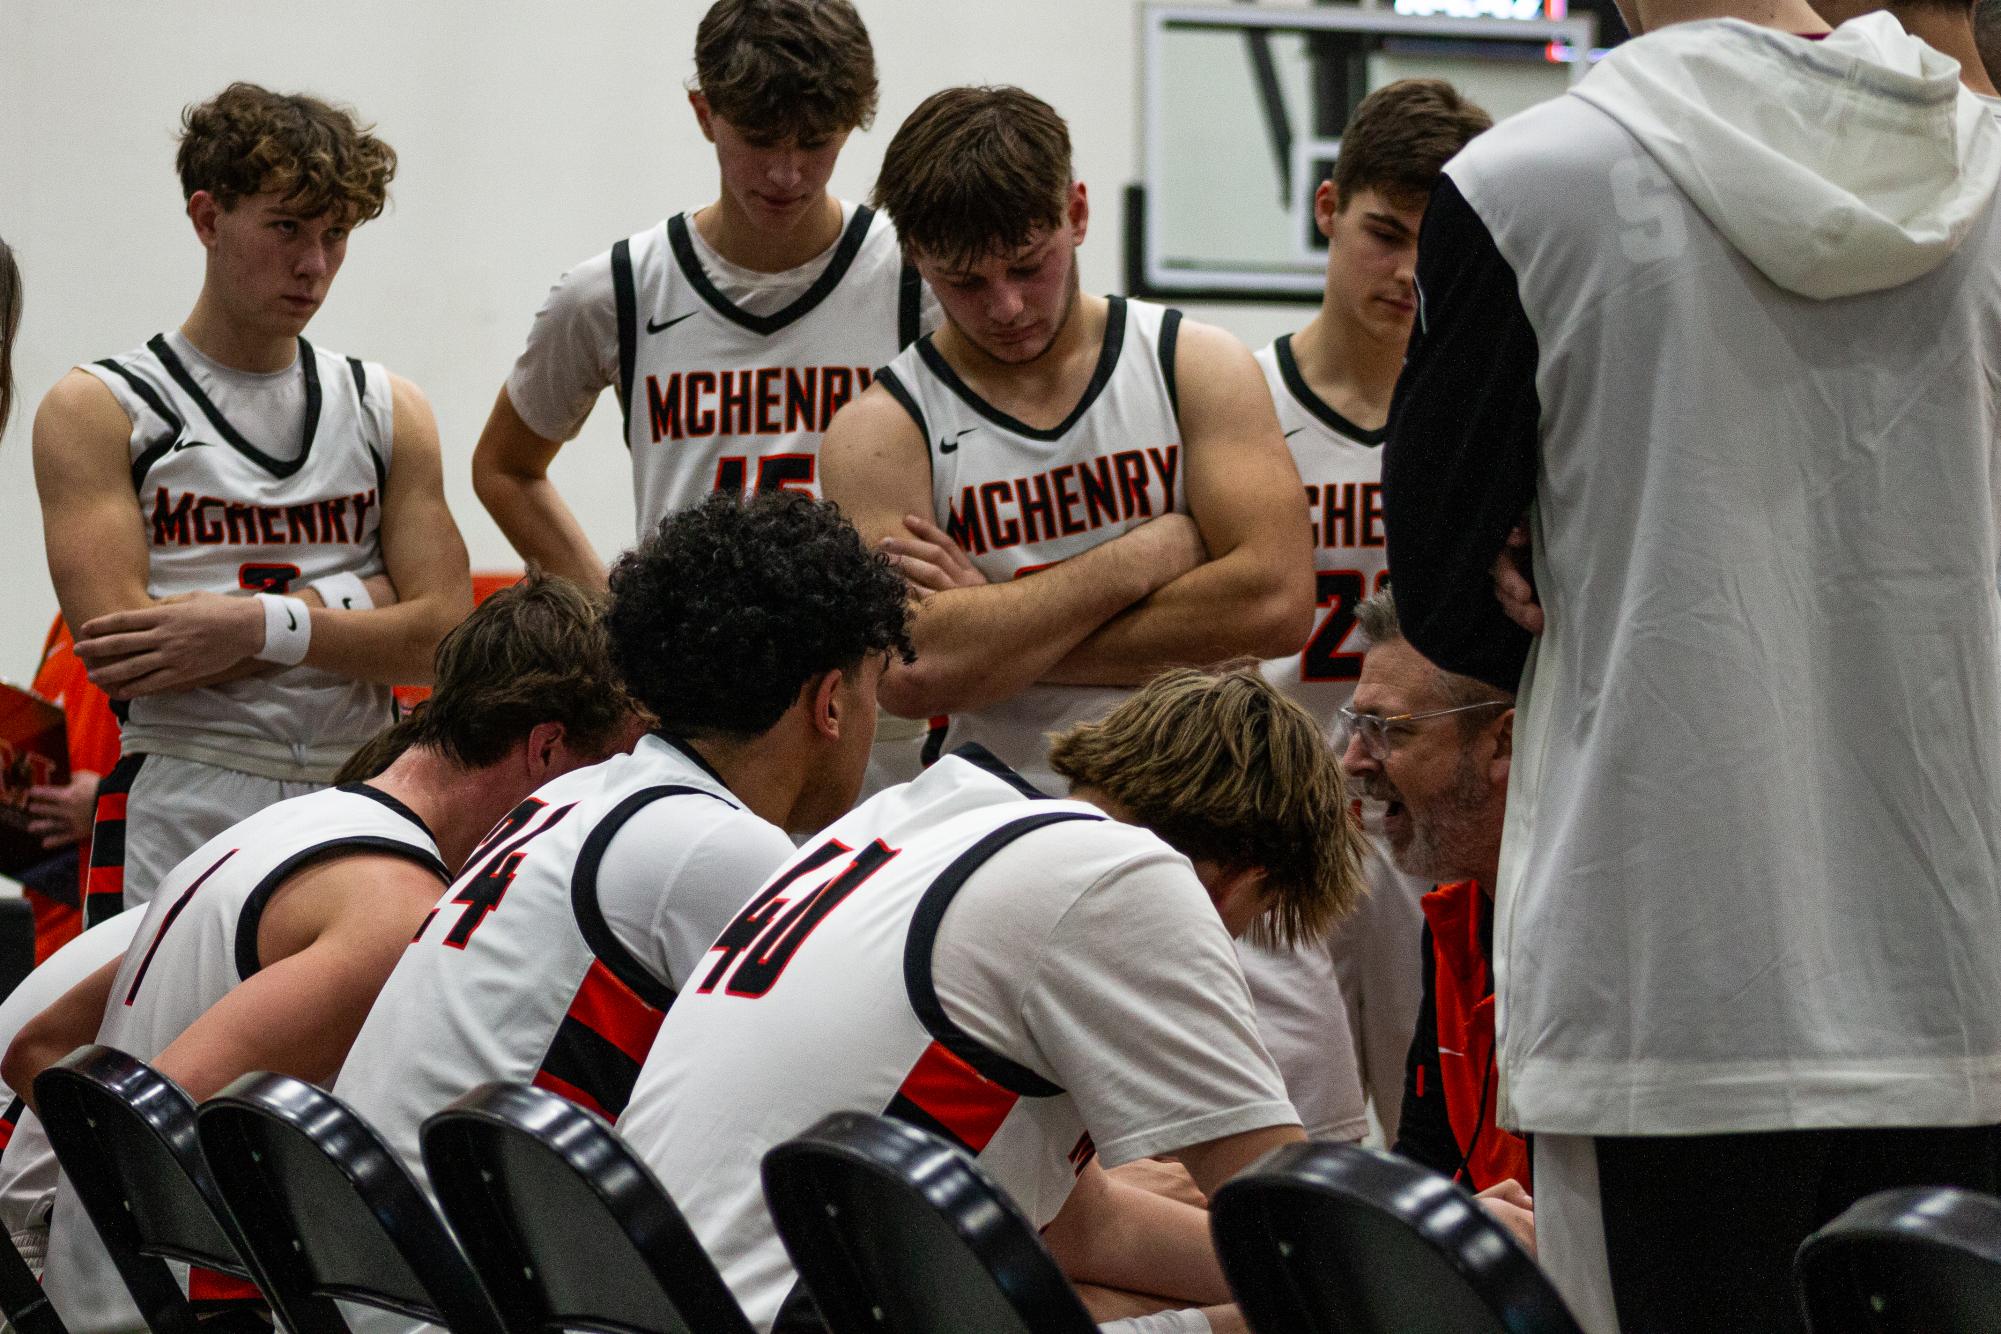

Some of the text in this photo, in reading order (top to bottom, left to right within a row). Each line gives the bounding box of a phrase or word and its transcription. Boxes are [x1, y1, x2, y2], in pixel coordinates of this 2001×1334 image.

[152, 487, 375, 546] MCHENRY
[945, 445, 1178, 556] MCHENRY
[1302, 569, 1392, 683] 2
[695, 837, 902, 999] 40
